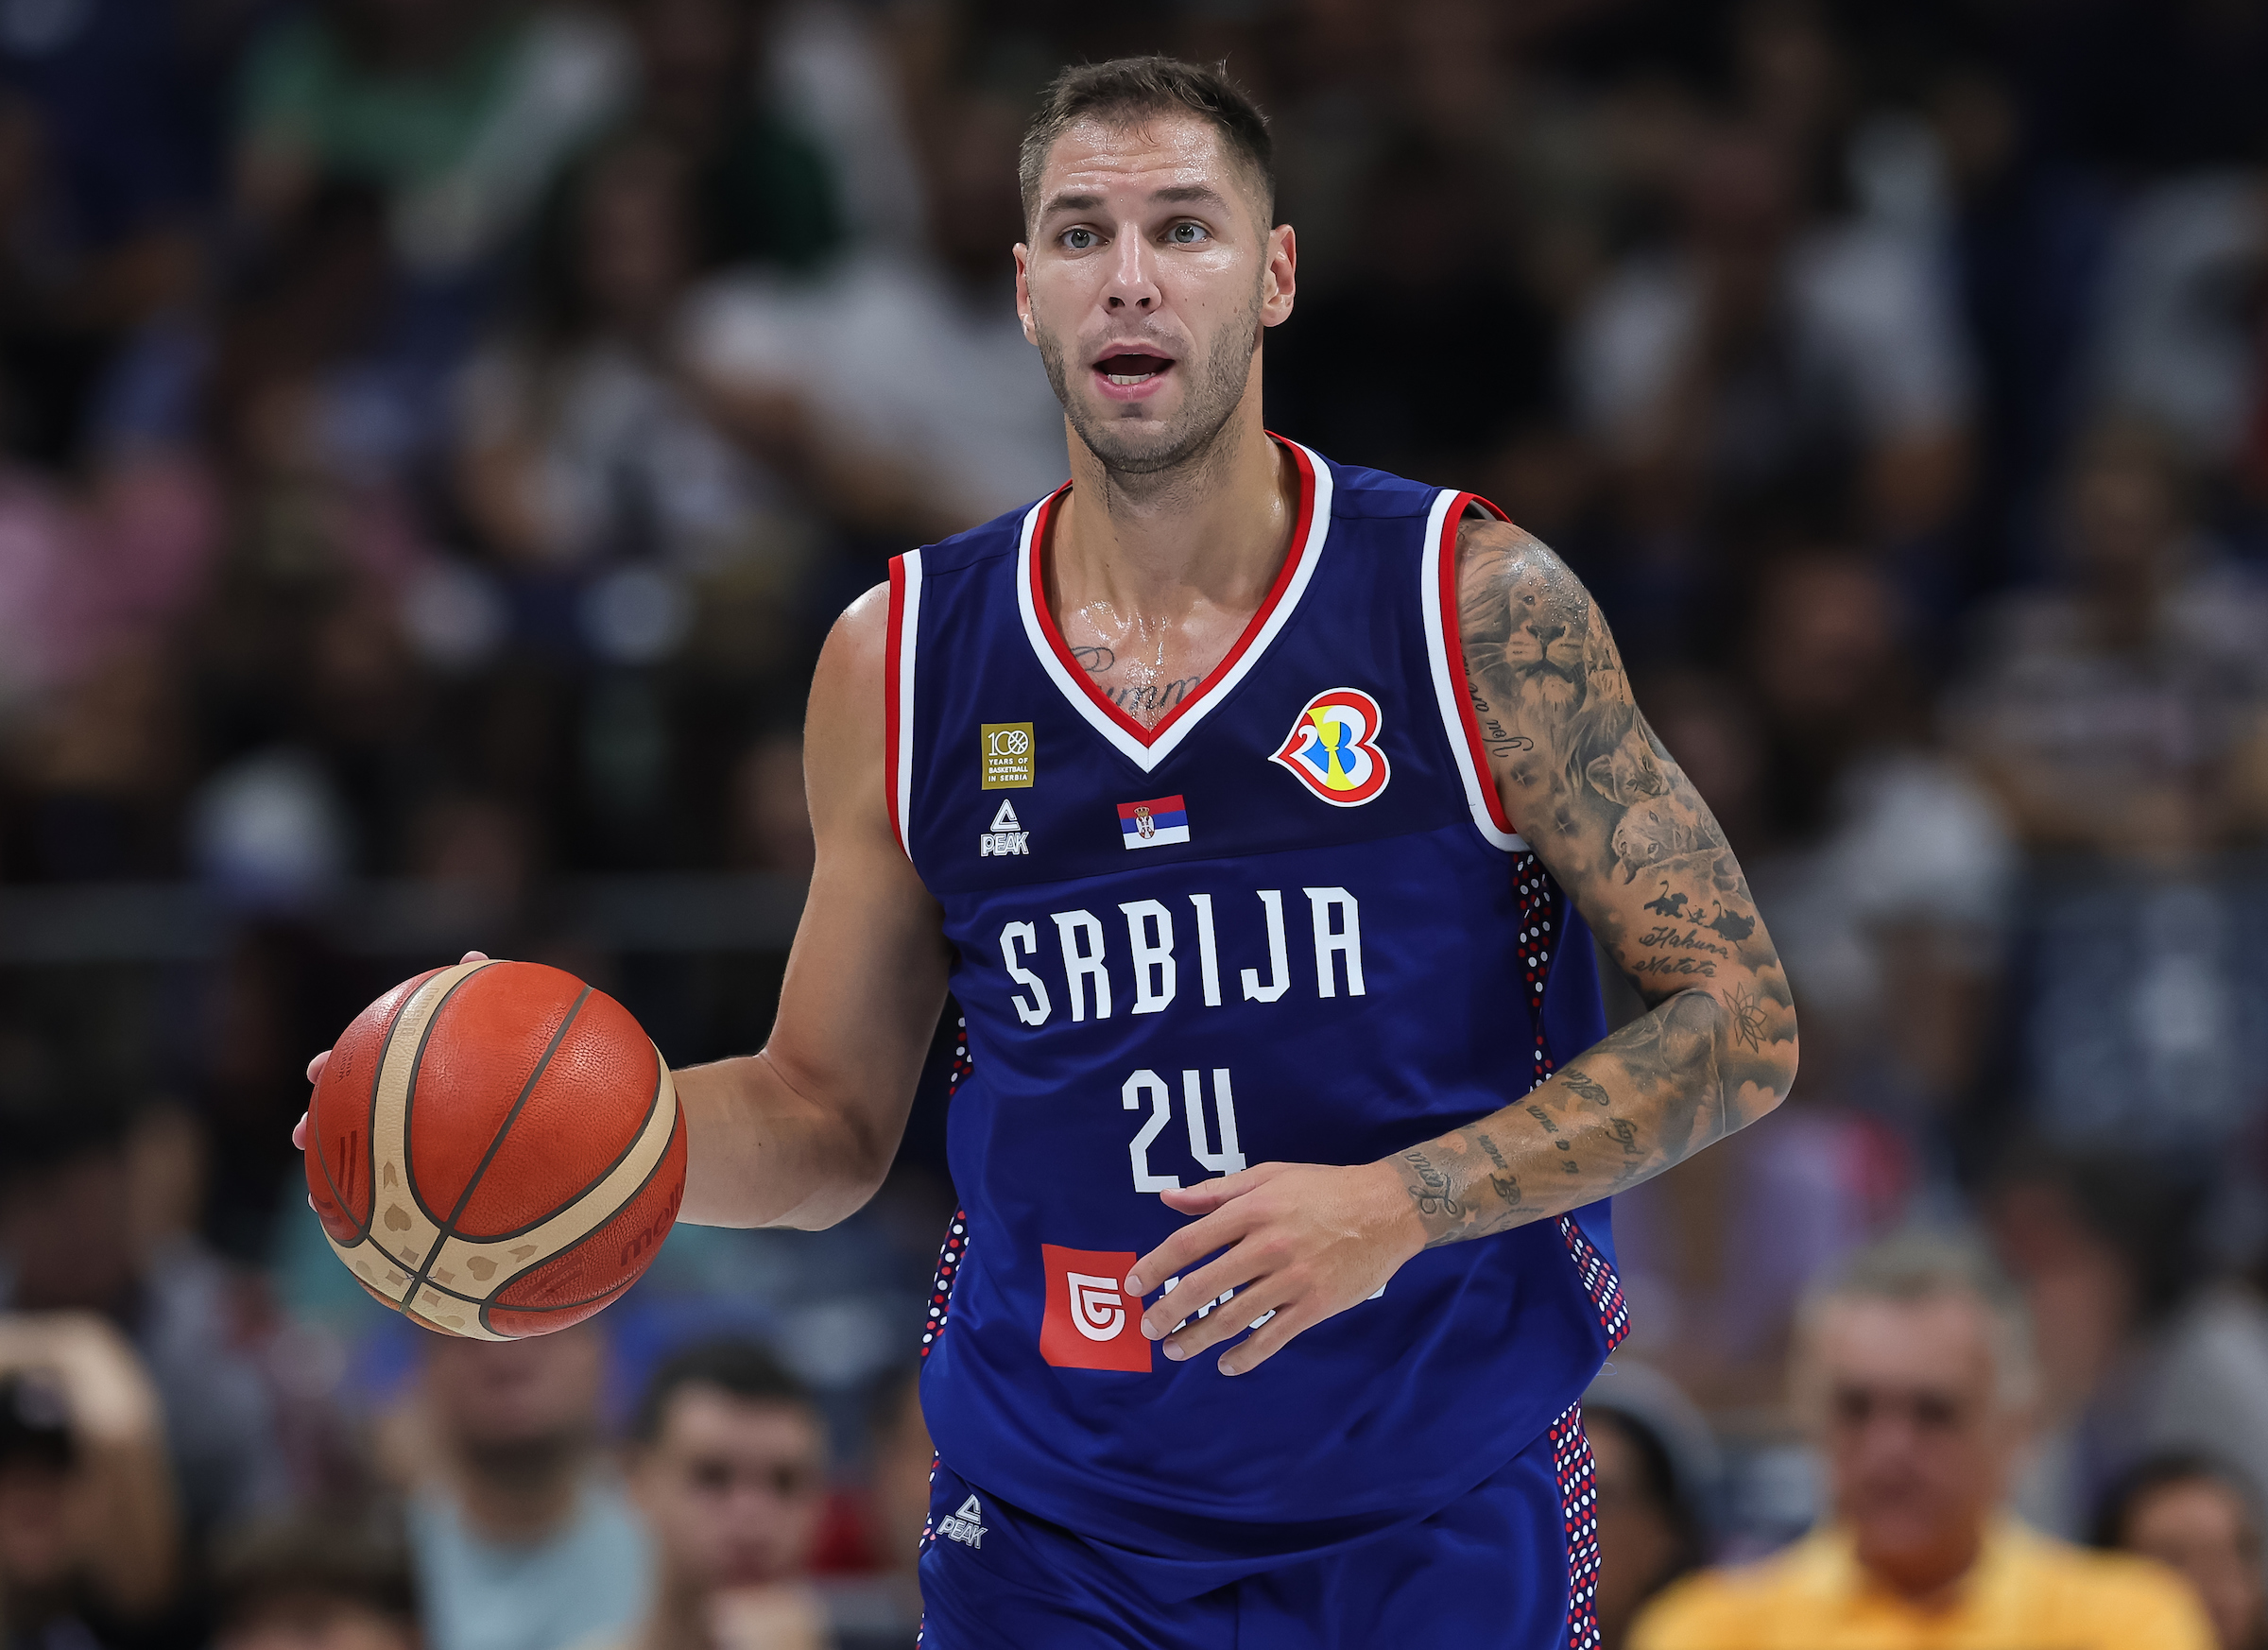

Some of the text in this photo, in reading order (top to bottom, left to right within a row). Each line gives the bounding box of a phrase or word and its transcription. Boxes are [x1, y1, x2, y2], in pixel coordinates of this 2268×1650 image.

[988, 730, 1029, 757] 100
[988, 765, 1029, 774] BASKETBALL
[980, 831, 1030, 857] PEAK
[999, 886, 1366, 1026] SRBIJA
[1121, 1067, 1247, 1194] 24
[935, 1514, 989, 1550] PEAK
